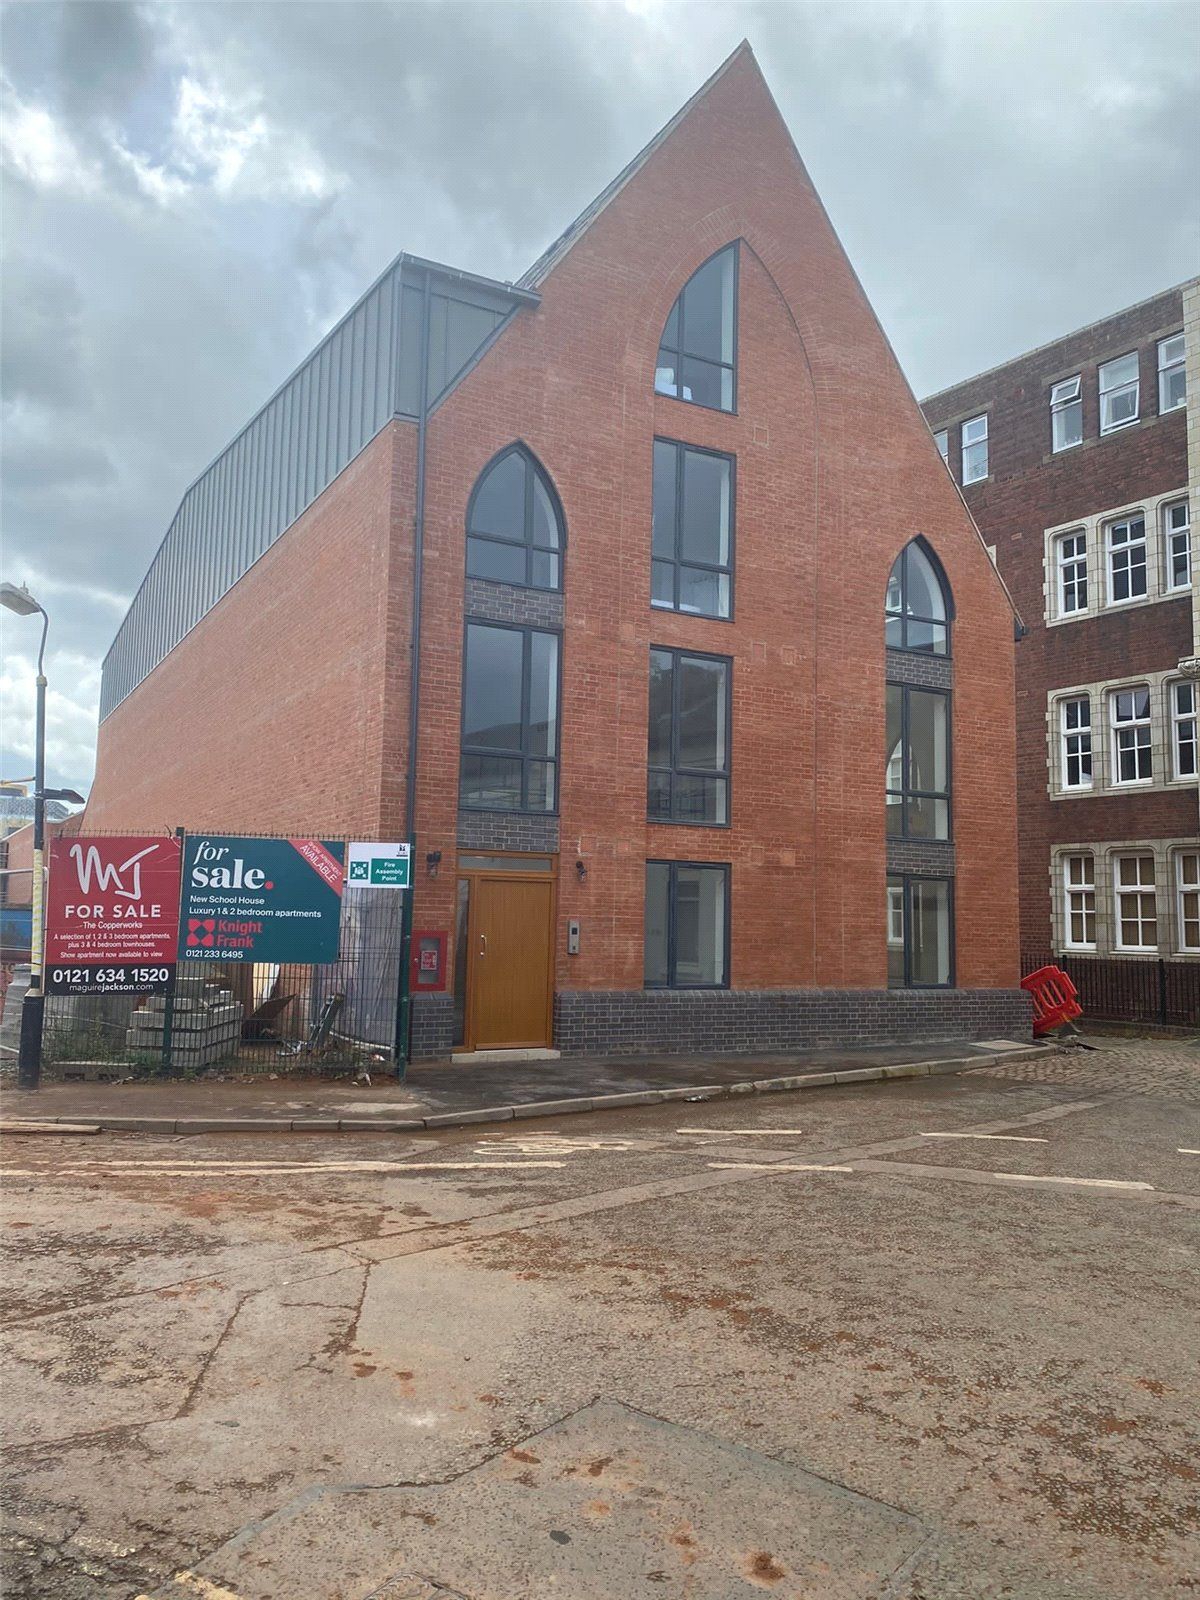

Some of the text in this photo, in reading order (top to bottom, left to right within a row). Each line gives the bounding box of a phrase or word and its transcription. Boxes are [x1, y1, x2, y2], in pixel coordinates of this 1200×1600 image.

[193, 840, 229, 865] for
[300, 844, 338, 883] AVAILABLE
[190, 895, 265, 905] New School House
[65, 904, 161, 919] FOR SALE
[189, 907, 216, 916] Luxury
[229, 907, 236, 915] 2
[236, 908, 274, 917] bedroom
[274, 910, 322, 919] apartments
[83, 921, 143, 930] The Copperworks
[219, 920, 263, 935] Knight
[216, 935, 254, 948] Frank
[60, 951, 76, 959] Show
[77, 951, 105, 960] apartment
[105, 951, 117, 959] now
[118, 951, 142, 959] available
[185, 949, 244, 959] 0121 233 6495
[52, 968, 169, 983] 0121 634 1520
[69, 982, 154, 993] maguirejackson.com
